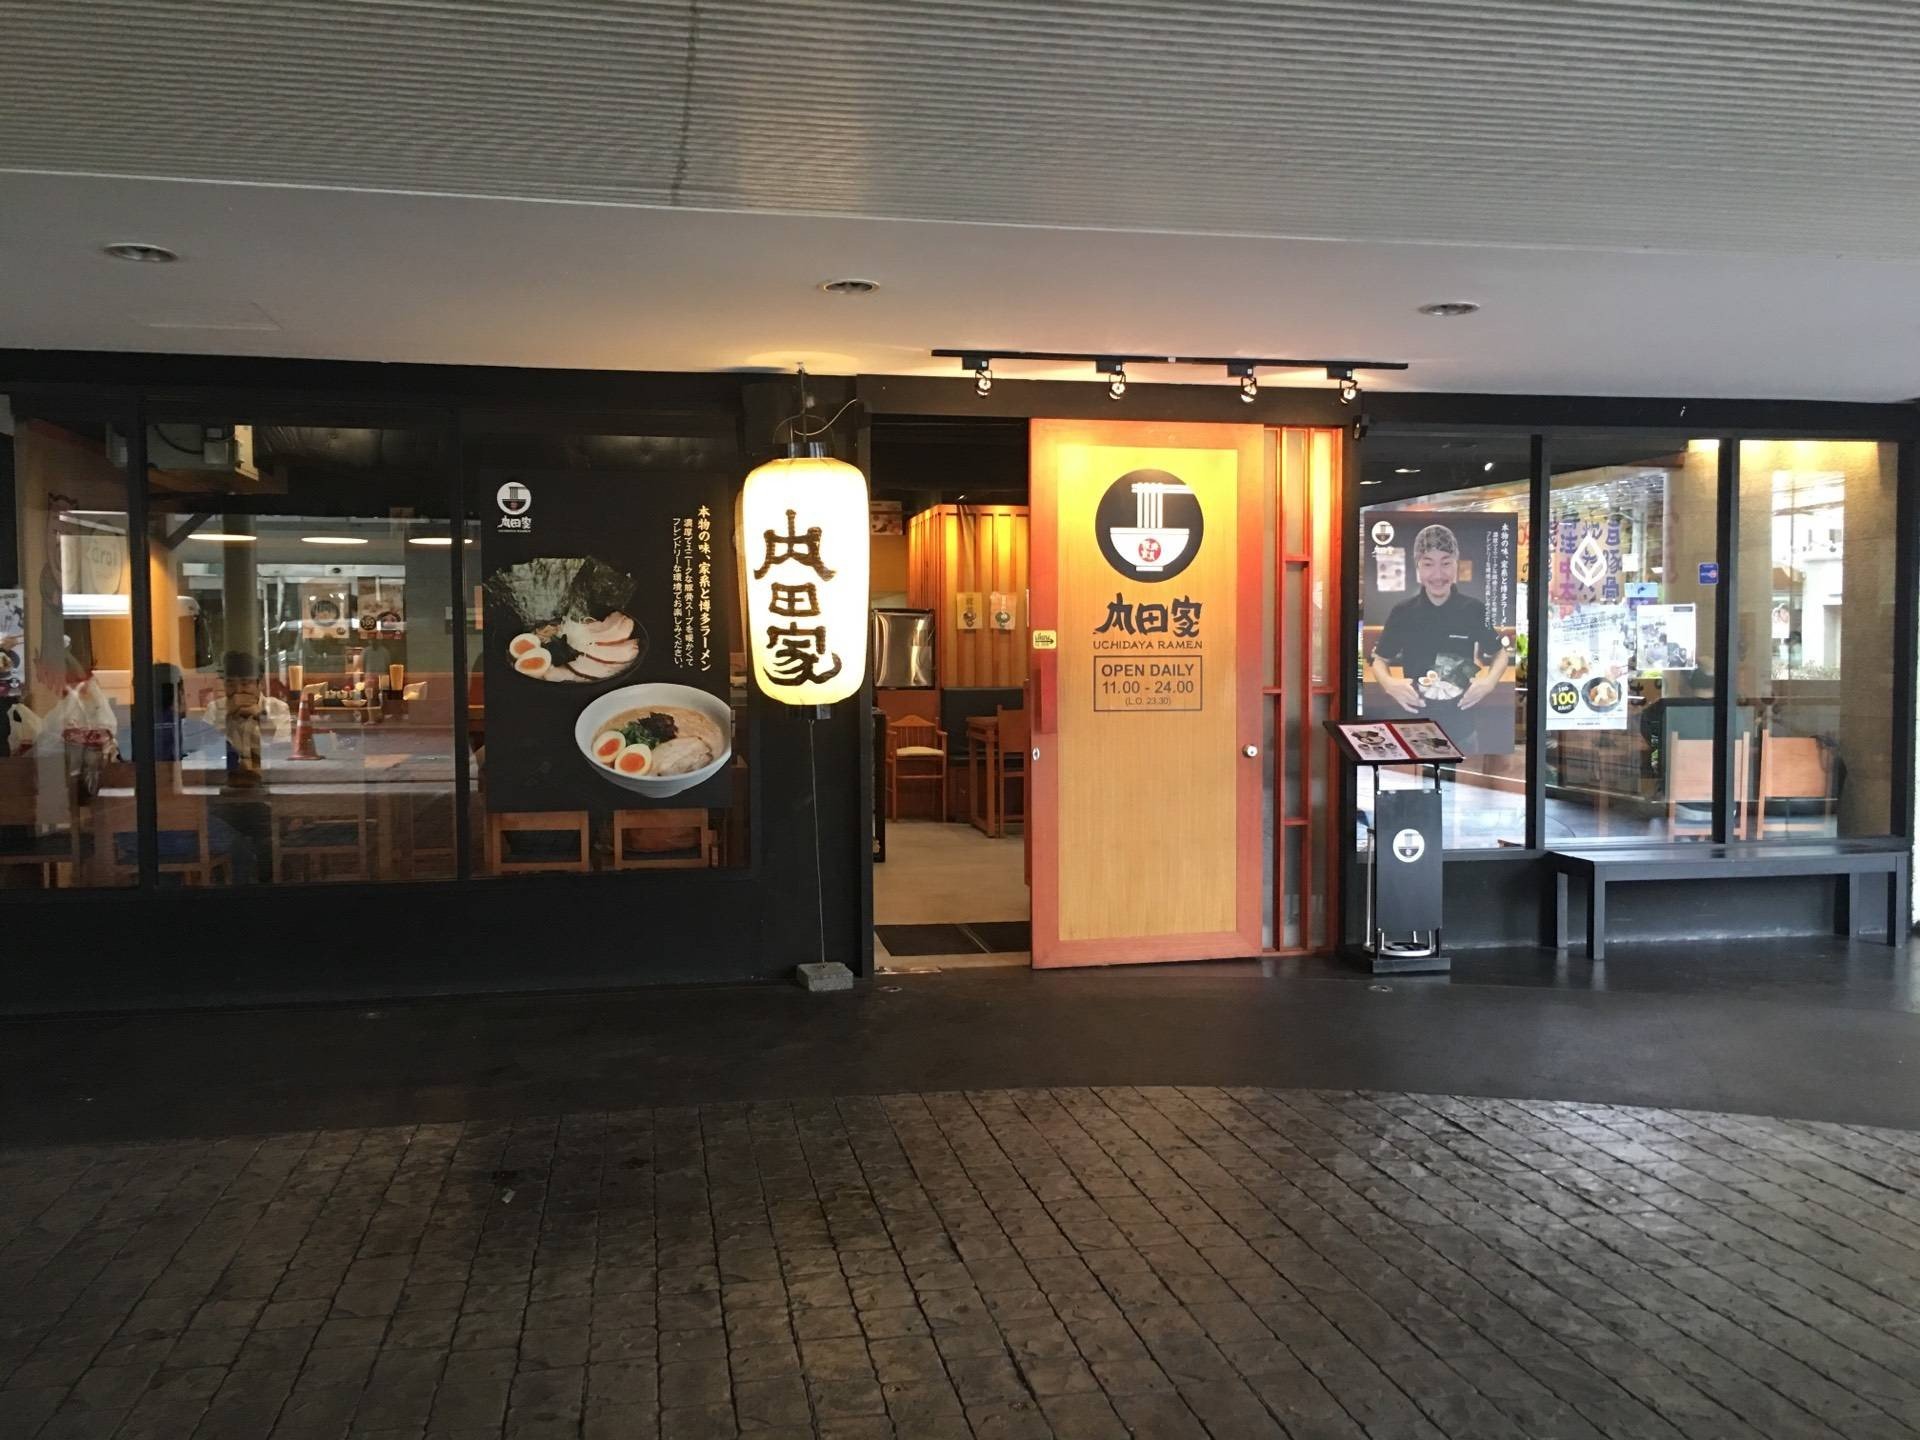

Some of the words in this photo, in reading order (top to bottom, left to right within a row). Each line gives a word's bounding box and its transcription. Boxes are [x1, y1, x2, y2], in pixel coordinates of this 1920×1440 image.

[753, 509, 842, 686] 内田家
[1093, 640, 1154, 650] UCHIDAYA
[1158, 640, 1202, 650] RAMEN
[1101, 664, 1145, 677] OPEN
[1150, 664, 1194, 676] DAILY
[1102, 681, 1140, 694] 11.00
[1154, 681, 1194, 694] 24.00
[1551, 691, 1576, 705] 100
